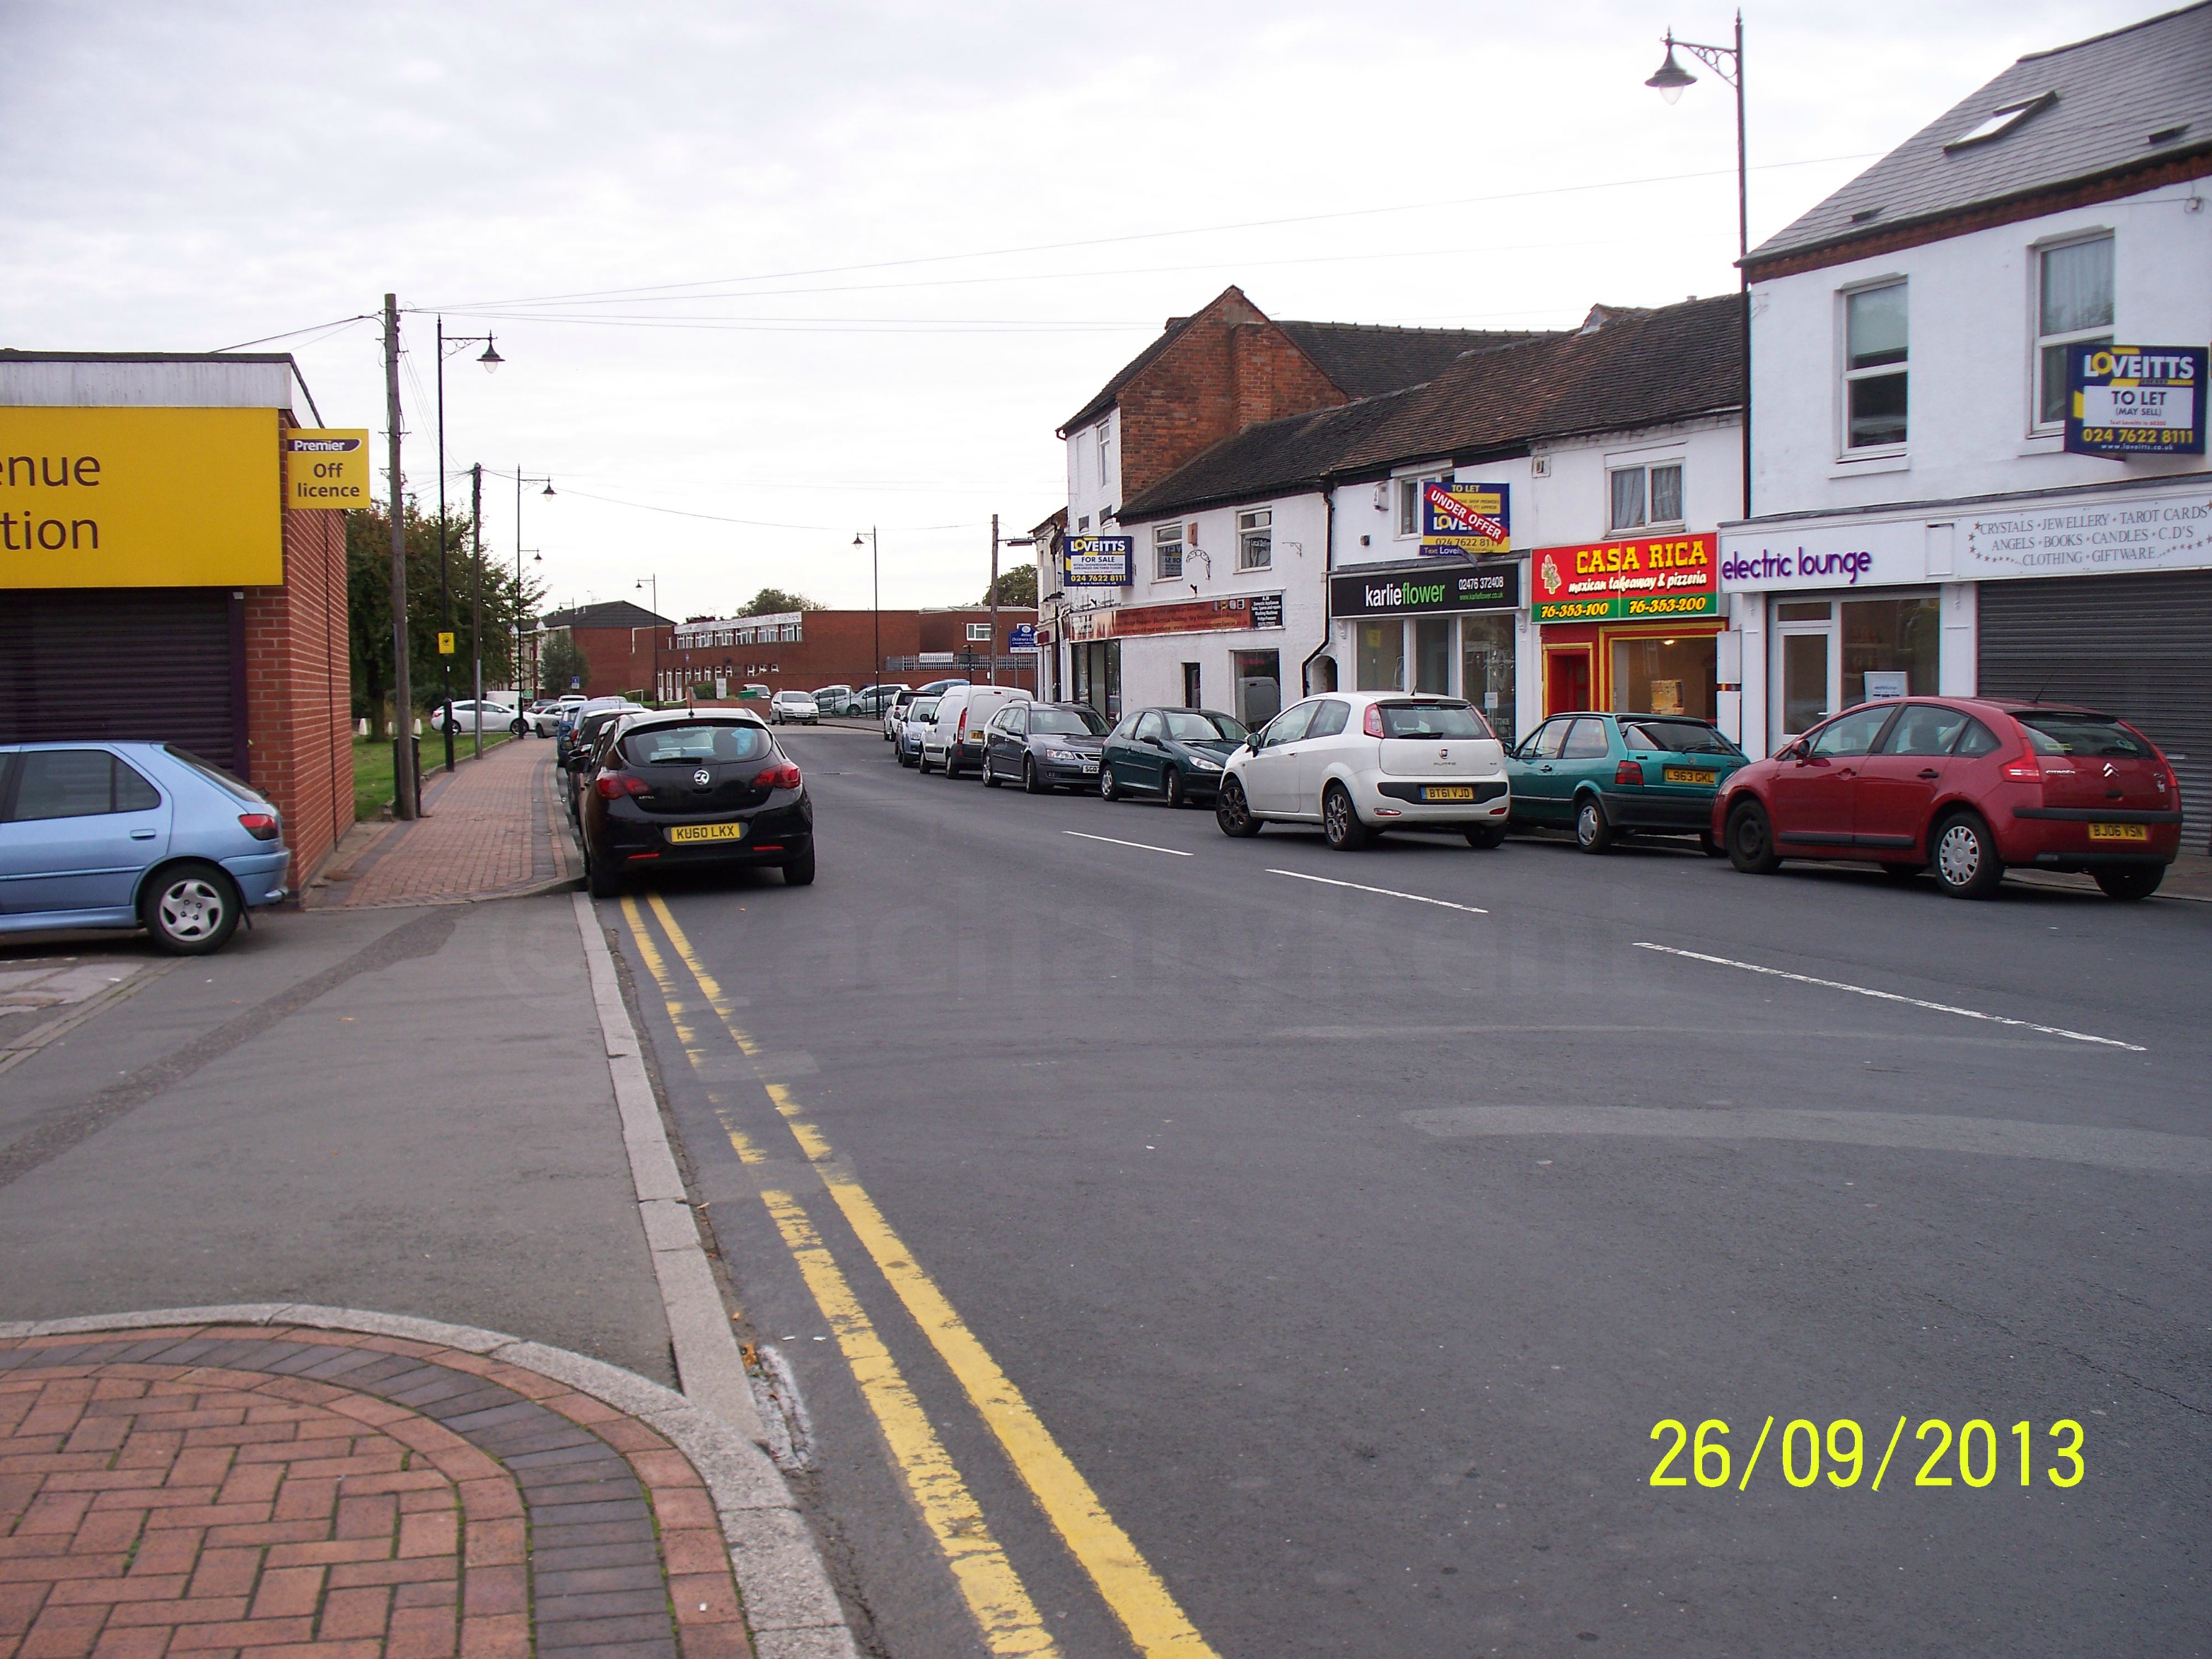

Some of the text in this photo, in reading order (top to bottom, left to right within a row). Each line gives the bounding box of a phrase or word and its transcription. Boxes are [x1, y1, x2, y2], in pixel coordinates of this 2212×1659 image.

[2083, 351, 2194, 379] LOVEITTS
[2112, 390, 2167, 406] TO LET
[2116, 407, 2162, 417] (MAY SELL)
[2083, 428, 2193, 443] 024 7622 8111
[294, 440, 345, 451] Premier
[0, 456, 100, 487] nue
[313, 462, 344, 478] Off
[298, 482, 360, 497] licence
[1431, 489, 1502, 540] UNDER OFFER
[1981, 506, 2208, 535] CRYSTALS JEWELLERY TAROT CARDS
[1071, 539, 1126, 552] LOVEITTS
[1991, 537, 2035, 551] ANGELS
[2044, 533, 2083, 548] BOOKS
[2092, 529, 2148, 545] CANDLES
[1576, 540, 1709, 574] CASA RICA
[2022, 547, 2155, 566] CLOTHING GIFTWARE
[1722, 546, 1872, 584] electric lounge
[1458, 576, 1504, 590] 02476 372408
[1568, 571, 1708, 593] mexican takeaway & pizzeria
[1365, 582, 1445, 607] karlieflower
[1540, 597, 1707, 619] 76-353-100 76-353-200
[1667, 770, 1714, 784] L963 GKL
[1429, 788, 1450, 798] BT61
[677, 825, 735, 839] KU60 LKX
[2093, 825, 2121, 837] BJ06
